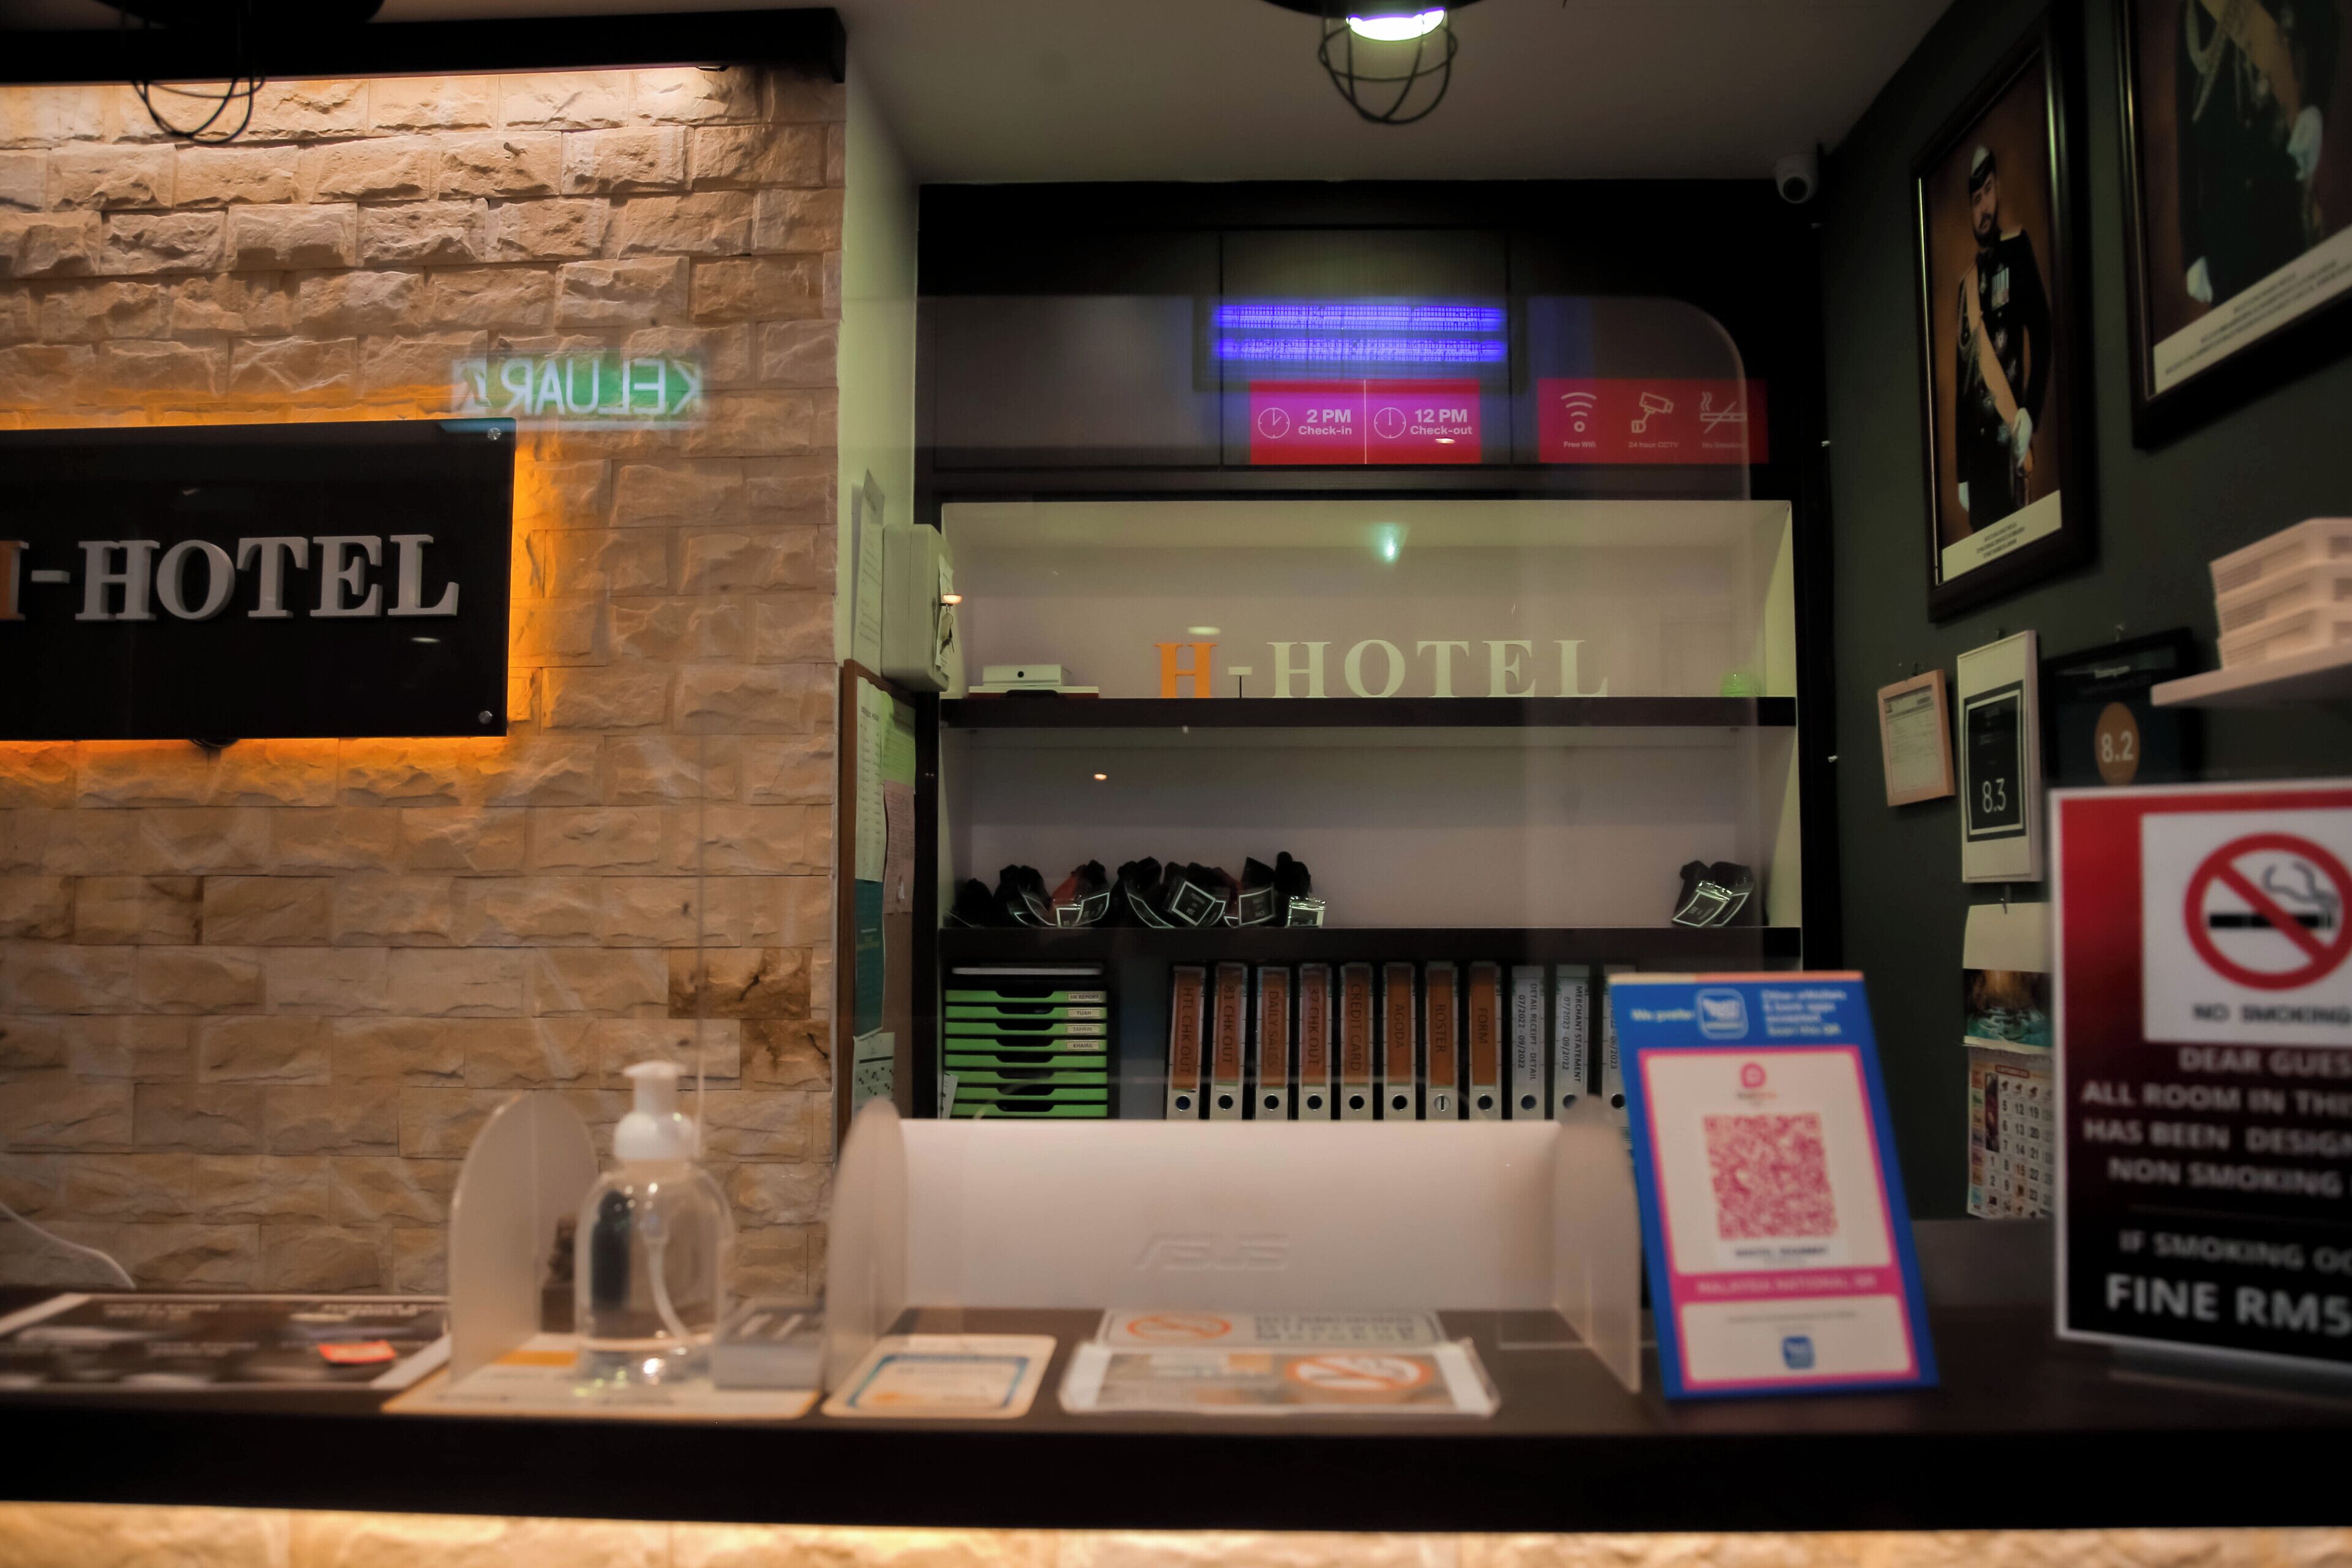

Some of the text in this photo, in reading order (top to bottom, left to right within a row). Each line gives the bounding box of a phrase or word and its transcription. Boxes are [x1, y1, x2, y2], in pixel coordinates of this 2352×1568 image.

[1298, 426, 1352, 435] Check-in
[1306, 409, 1351, 423] 2 PM
[1410, 426, 1472, 435] Check-out
[1415, 409, 1468, 423] 12 PM
[1153, 639, 1608, 699] H-HOTEL
[2101, 730, 2134, 763] 8.2
[1982, 778, 2007, 813] 8.3
[1223, 1006, 1234, 1031] CHK
[1267, 991, 1279, 1068] DAILY SALES
[1308, 1008, 1319, 1033] CHK
[1350, 984, 1362, 1071] CREDIT CARD
[1394, 1005, 1404, 1049] AGODA
[1436, 1005, 1447, 1053] ROSTER
[1477, 1008, 1488, 1044] FORM
[2193, 1005, 2230, 1022] NO
[1180, 987, 1193, 1074] HTL CHK OUT
[1223, 1037, 1233, 1065] OUT
[1308, 1038, 1319, 1066] OUT
[2179, 1049, 2261, 1073] DEAR
[2081, 1080, 2134, 1106] ALL
[2143, 1083, 2241, 1111] ROOM
[2248, 1089, 2285, 1114] IN
[2082, 1118, 2144, 1145] HAS
[2149, 1121, 2231, 1150] BEEN
[2108, 1157, 2342, 1197] NON SMOKING
[2119, 1229, 2145, 1253] IF
[2153, 1232, 2305, 1270] SMOKING
[2106, 1273, 2352, 1338] FINE RM5
